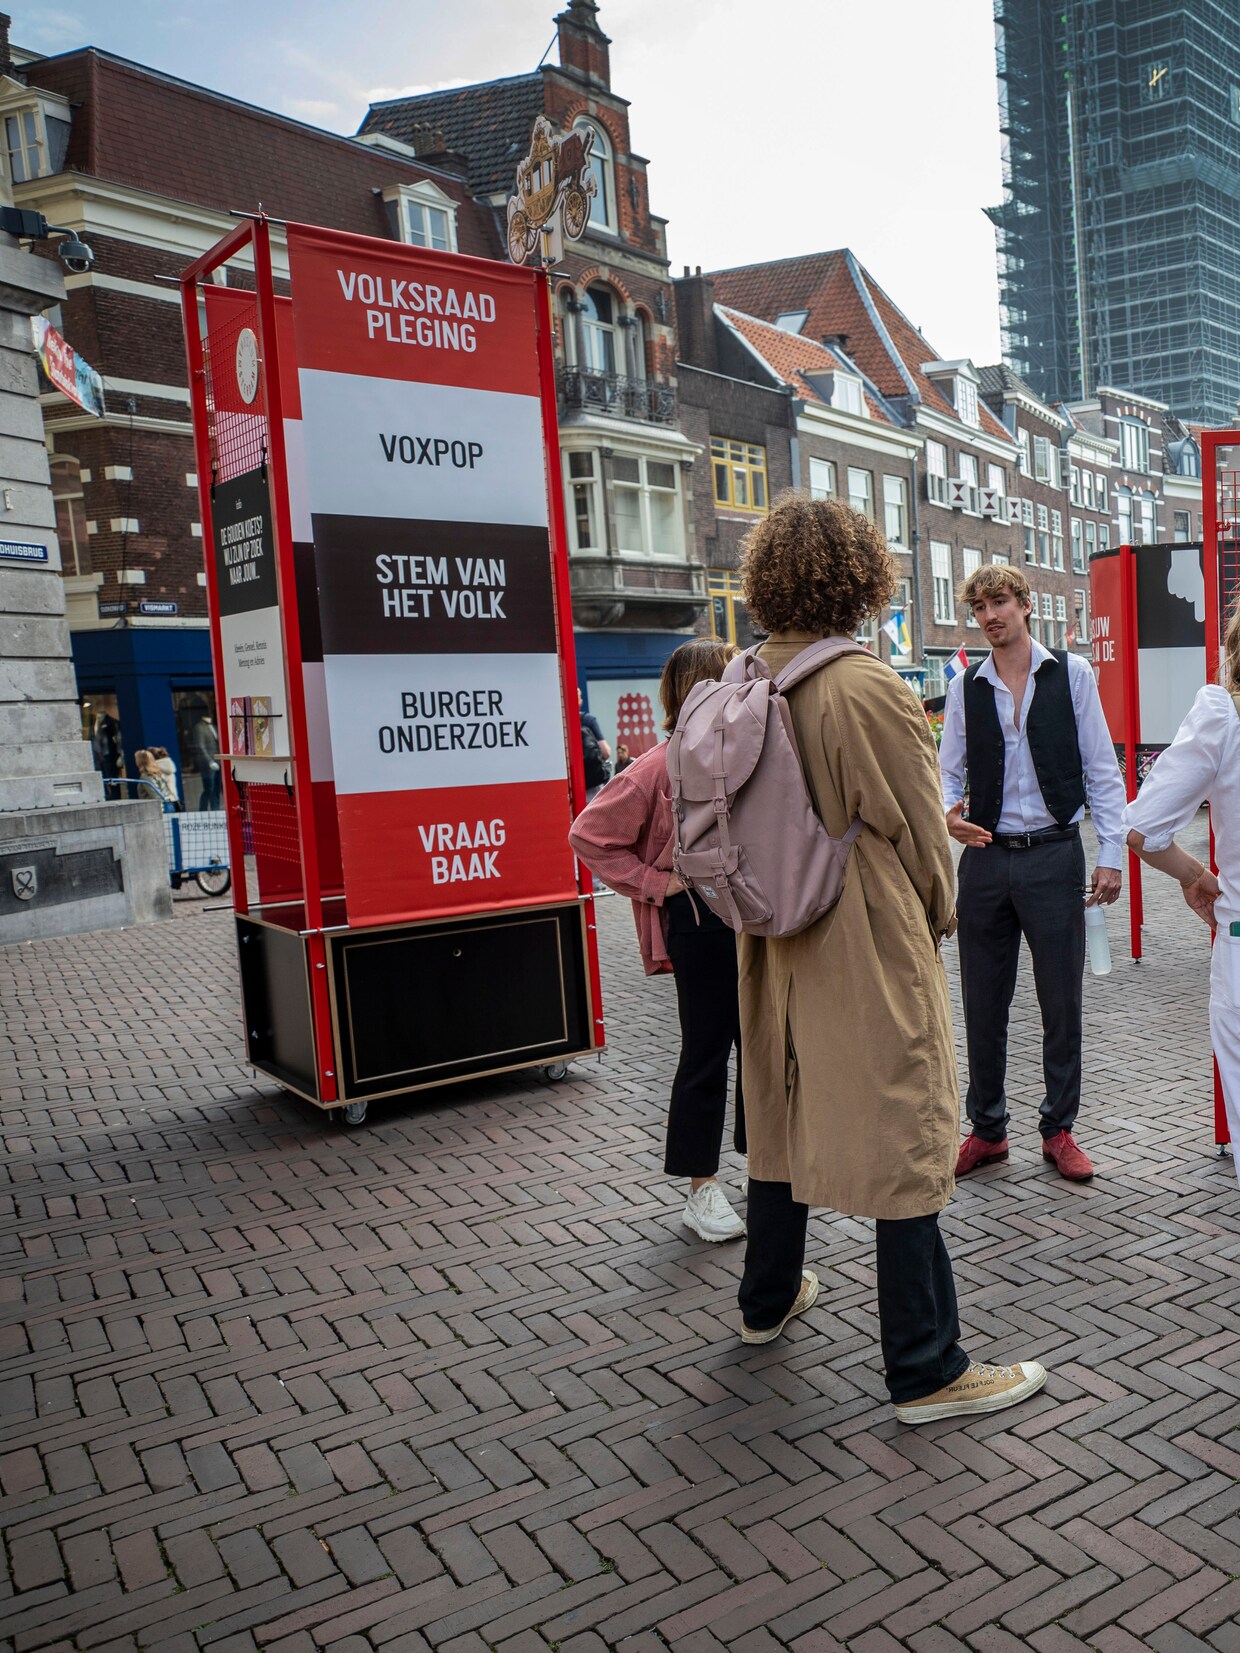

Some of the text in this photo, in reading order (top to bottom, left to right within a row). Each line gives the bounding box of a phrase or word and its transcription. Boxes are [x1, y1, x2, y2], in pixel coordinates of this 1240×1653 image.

[337, 270, 496, 323] VOLKSRAAD
[367, 309, 477, 353] PLEGING
[379, 433, 483, 469] VOXPOP
[375, 554, 507, 587] STEM VAN
[382, 588, 507, 619] HET VOLK
[1102, 640, 1115, 661] DE
[401, 690, 504, 719] BURGER
[378, 721, 529, 754] ONDERZOEK
[418, 819, 506, 853] VRAAG
[431, 851, 501, 885] BAAK
